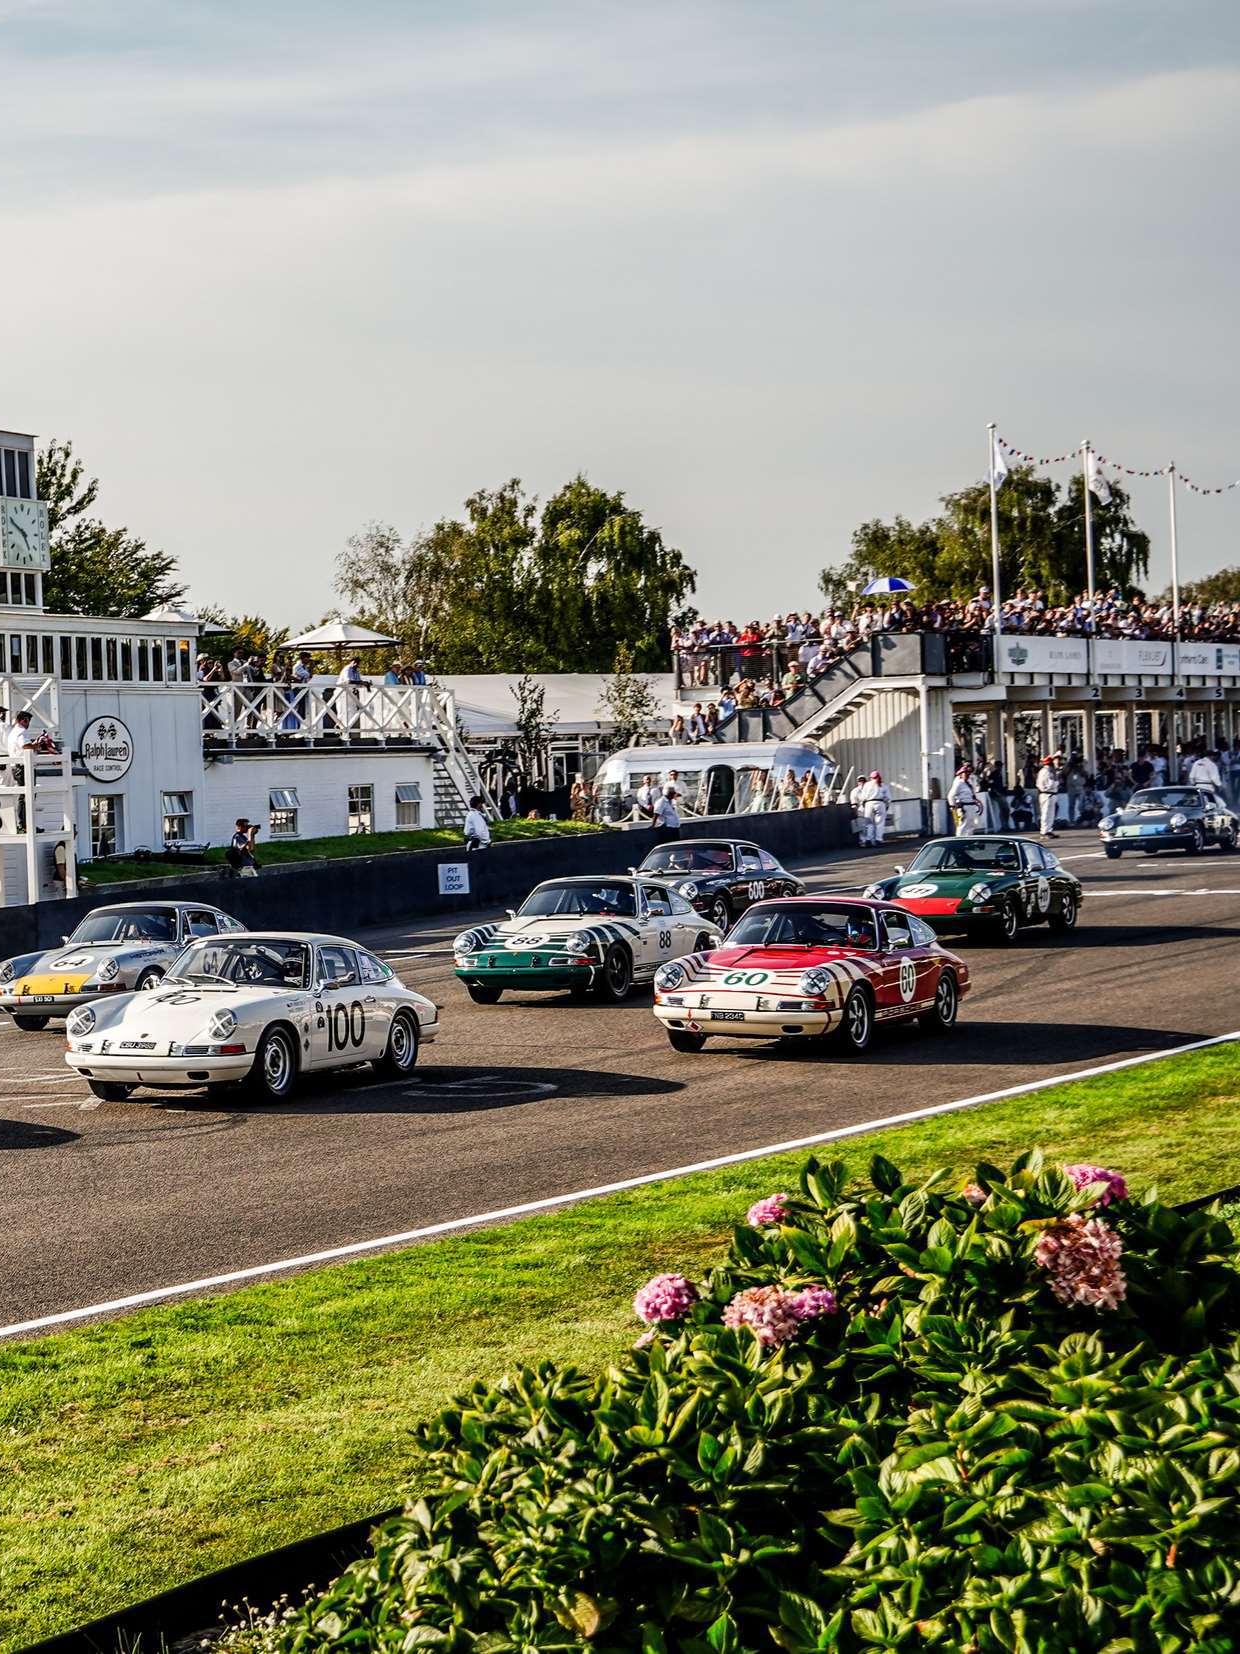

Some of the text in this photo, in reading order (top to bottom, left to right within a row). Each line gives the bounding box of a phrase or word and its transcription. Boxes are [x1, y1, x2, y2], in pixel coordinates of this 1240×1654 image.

[1092, 687, 1100, 697] 2
[1135, 688, 1143, 698] 3
[1176, 688, 1184, 697] 4
[1215, 688, 1222, 697] 5
[85, 742, 129, 761] Ralph Lauren
[444, 883, 464, 891] LOOP
[749, 881, 764, 899] 600
[512, 936, 543, 946] 88
[659, 930, 671, 948] 88
[55, 958, 86, 968] 64
[203, 951, 218, 974] 64
[724, 972, 768, 986] 60
[902, 964, 914, 994] 60
[326, 1000, 365, 1052] 100
